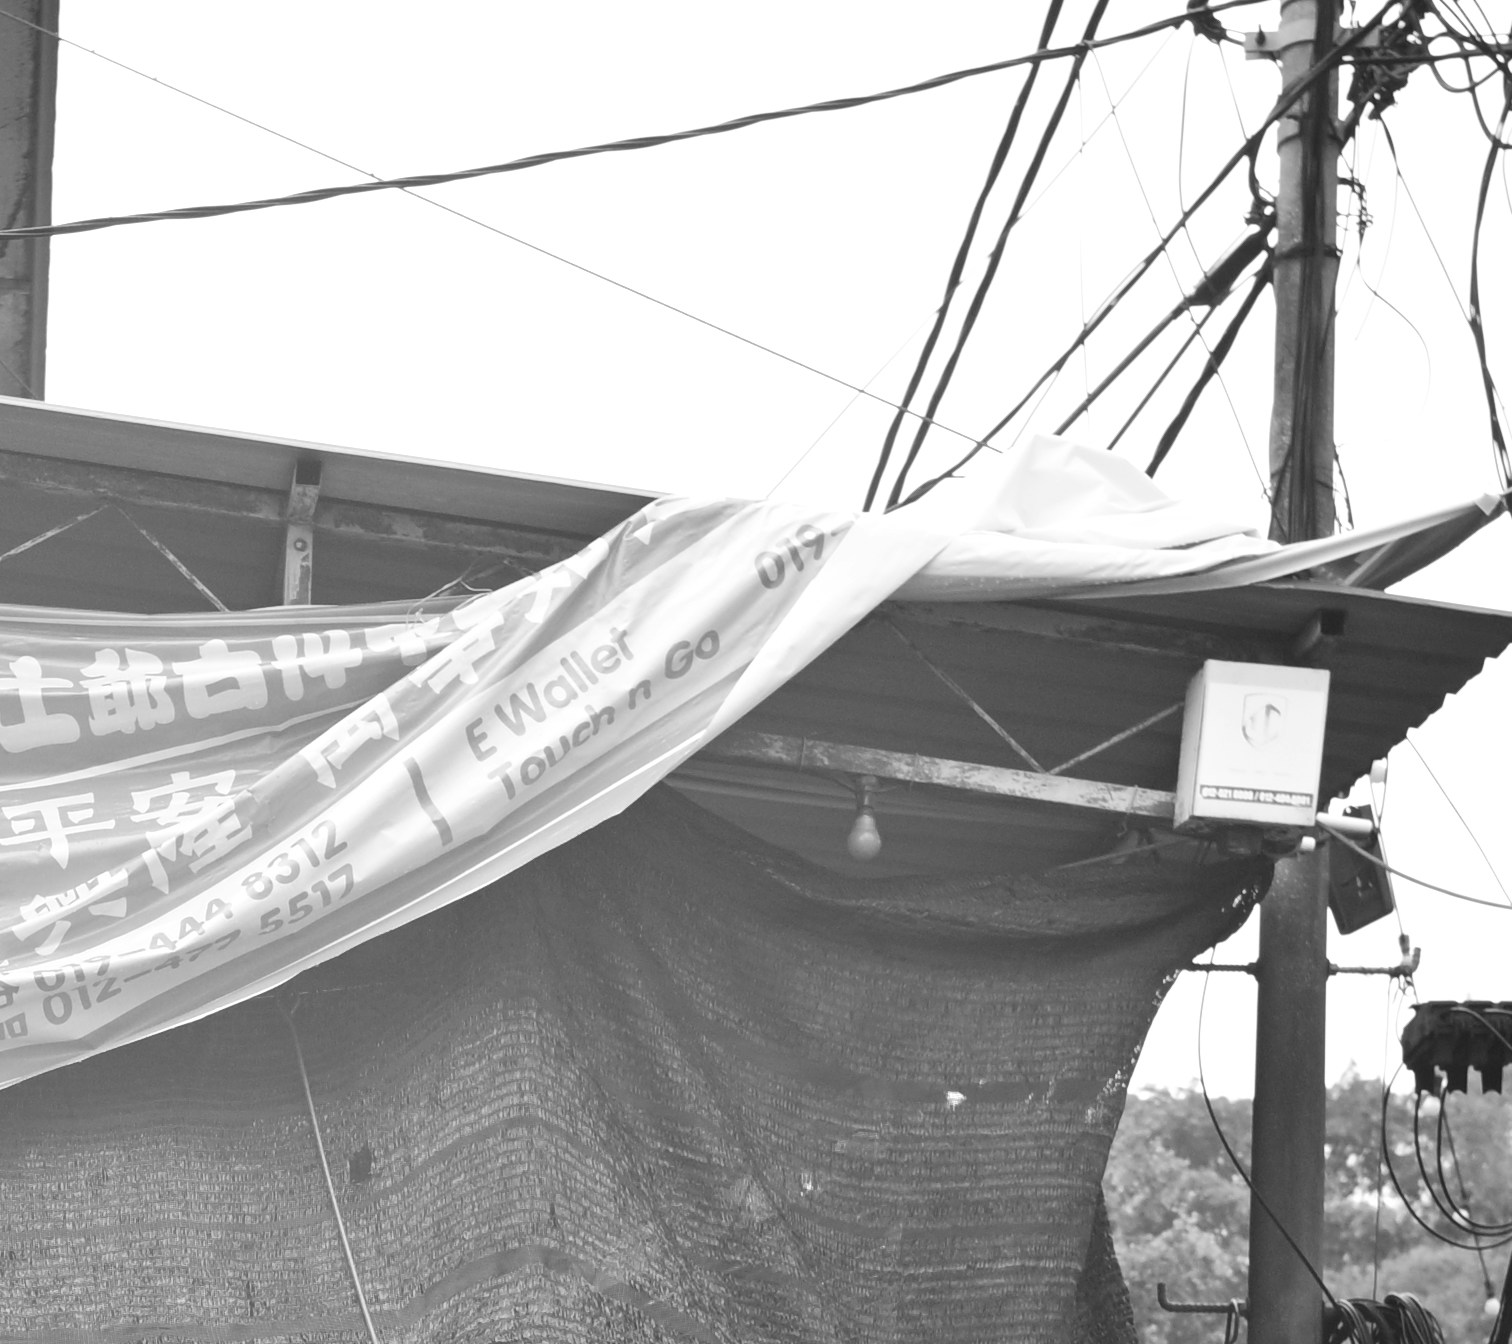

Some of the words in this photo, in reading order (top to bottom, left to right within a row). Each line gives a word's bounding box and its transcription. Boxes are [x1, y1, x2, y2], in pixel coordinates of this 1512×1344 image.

[465, 716, 498, 761] E
[494, 626, 635, 736] Wallet
[487, 704, 616, 800] Touch
[628, 680, 652, 709] n
[664, 630, 721, 679] Go
[241, 819, 348, 901] 8312
[258, 863, 355, 936] 5517
